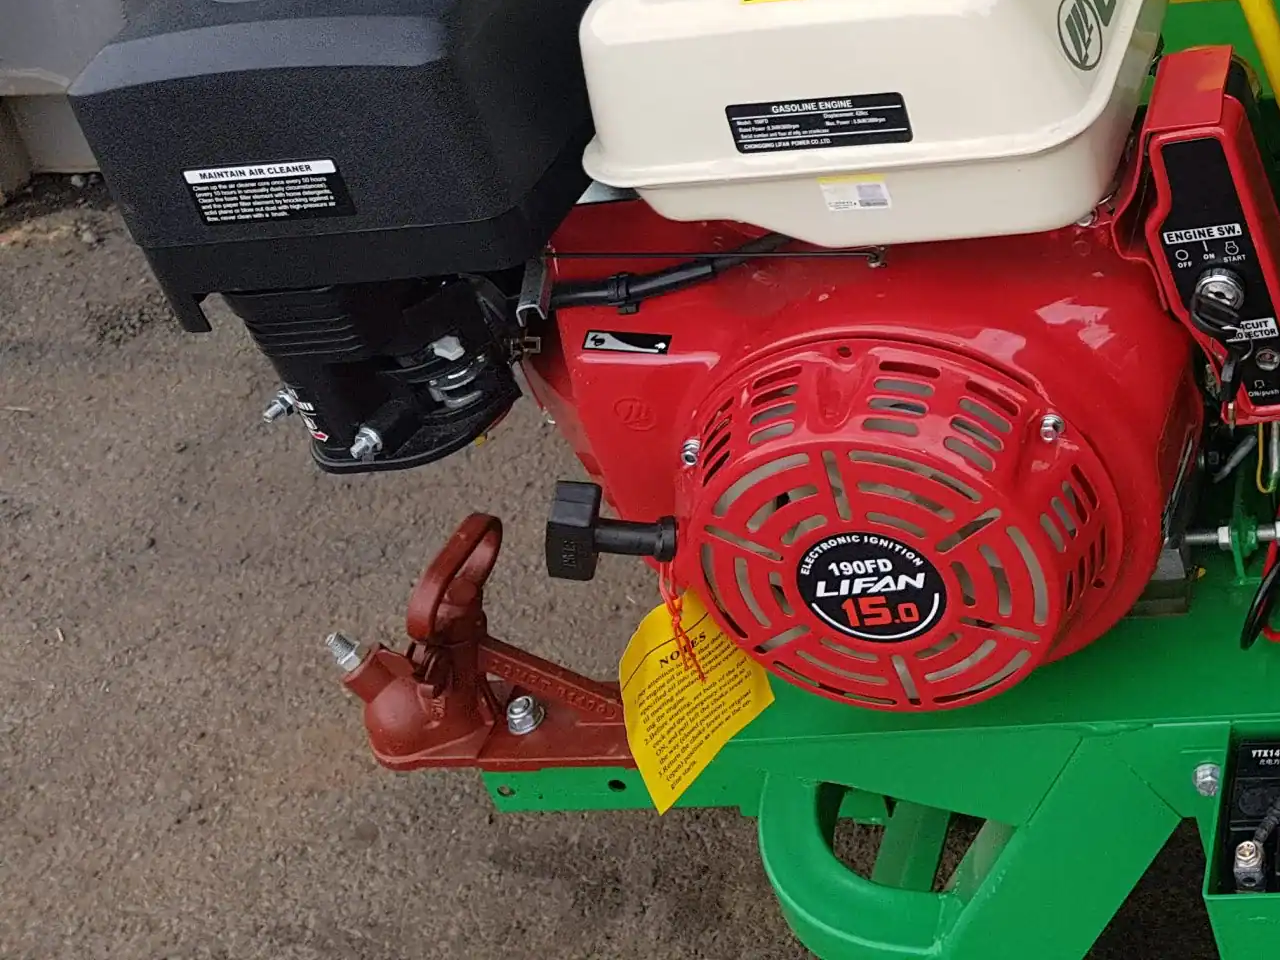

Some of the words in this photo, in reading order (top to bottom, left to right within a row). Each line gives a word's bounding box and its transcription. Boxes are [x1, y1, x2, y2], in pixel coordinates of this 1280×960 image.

[771, 102, 817, 113] GASOLINE
[819, 100, 853, 110] ENGINE
[199, 170, 247, 180] MAINTAIN
[249, 168, 266, 177] AIR
[267, 164, 313, 175] CLEANER
[1166, 228, 1214, 242] ENGINE
[1217, 225, 1240, 237] SW.
[1177, 260, 1192, 269] OFF
[1223, 254, 1246, 263] START
[800, 534, 861, 576] ELECTRONIC
[863, 535, 924, 567] IGNITION
[828, 557, 893, 577] 190FD
[816, 572, 926, 598] LIFAN
[841, 596, 920, 627] 15.0
